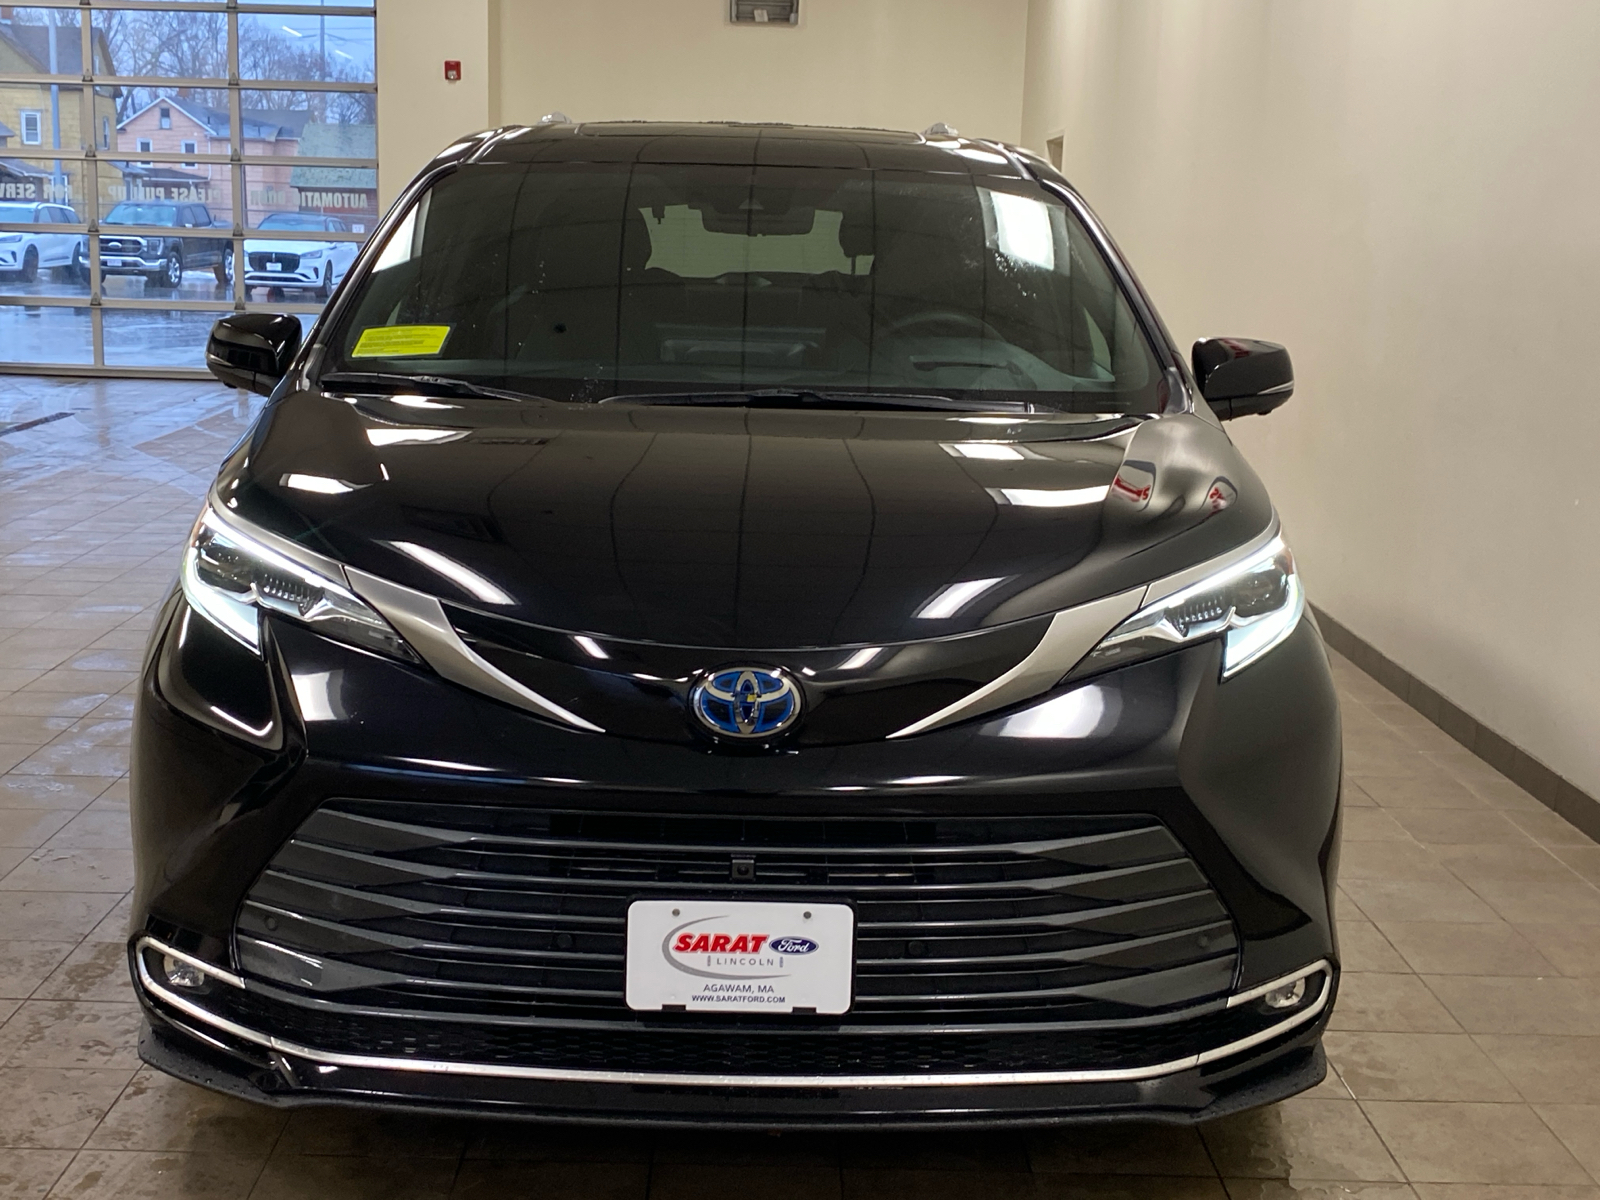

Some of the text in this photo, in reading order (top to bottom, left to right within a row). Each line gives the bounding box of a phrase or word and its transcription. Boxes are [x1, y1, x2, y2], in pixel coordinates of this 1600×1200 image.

[673, 933, 810, 954] SARAT Ford
[716, 957, 774, 966] LINCOLN
[703, 984, 774, 994] AGAWAM, MA
[691, 995, 786, 1003] WWW.SARATFORD.COM
